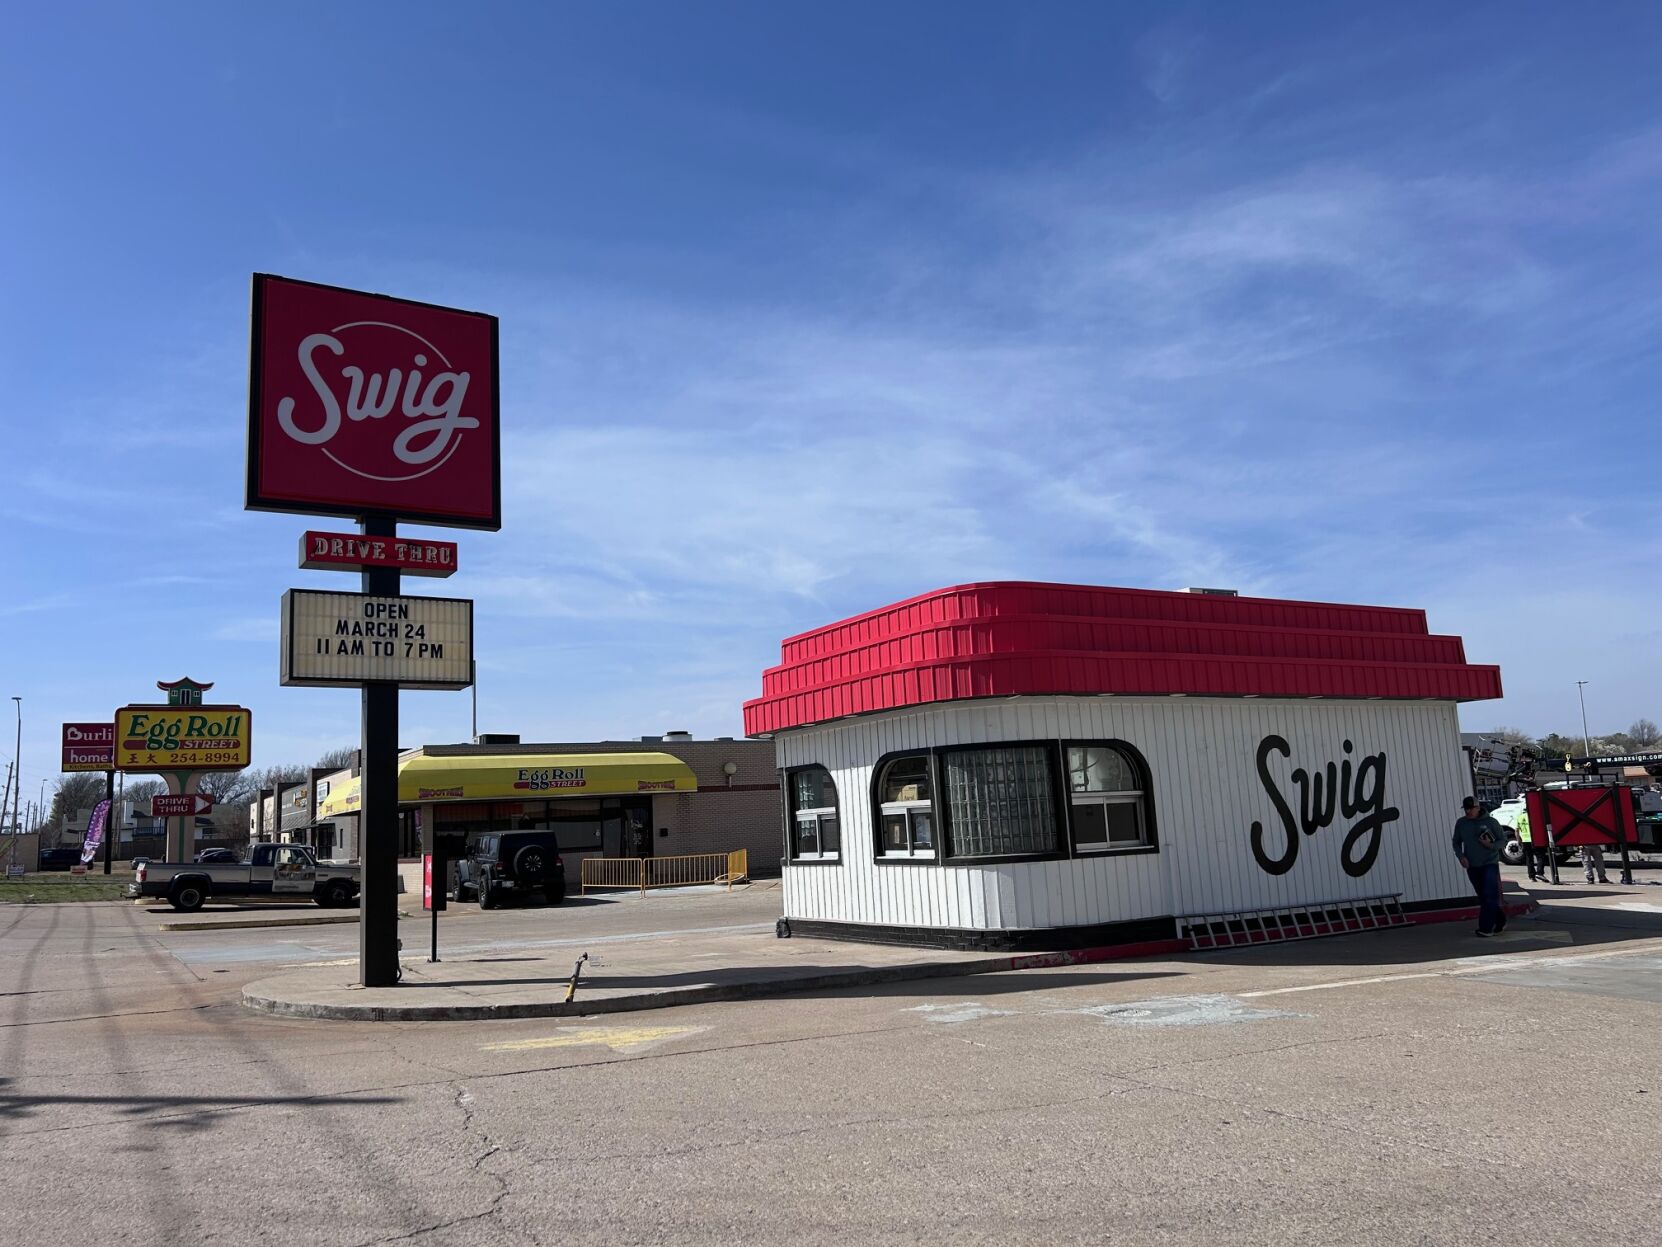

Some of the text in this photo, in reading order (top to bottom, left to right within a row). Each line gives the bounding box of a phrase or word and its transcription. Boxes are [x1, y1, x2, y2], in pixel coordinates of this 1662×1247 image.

[277, 333, 480, 465] Swig
[314, 537, 451, 564] DRIVE THRU
[364, 602, 408, 619] OPEN
[335, 620, 426, 640] MARCH 24
[317, 638, 443, 659] 11 AM TO 7 PM
[127, 714, 242, 751] Egg Roll
[183, 739, 239, 749] STREET
[70, 749, 109, 763] home
[170, 752, 241, 764] 254-8994
[518, 768, 584, 790] Egg Roll
[550, 779, 587, 788] STREET
[157, 797, 190, 806] DRIVE
[159, 805, 189, 814] THRU
[1251, 735, 1400, 878] Swig
